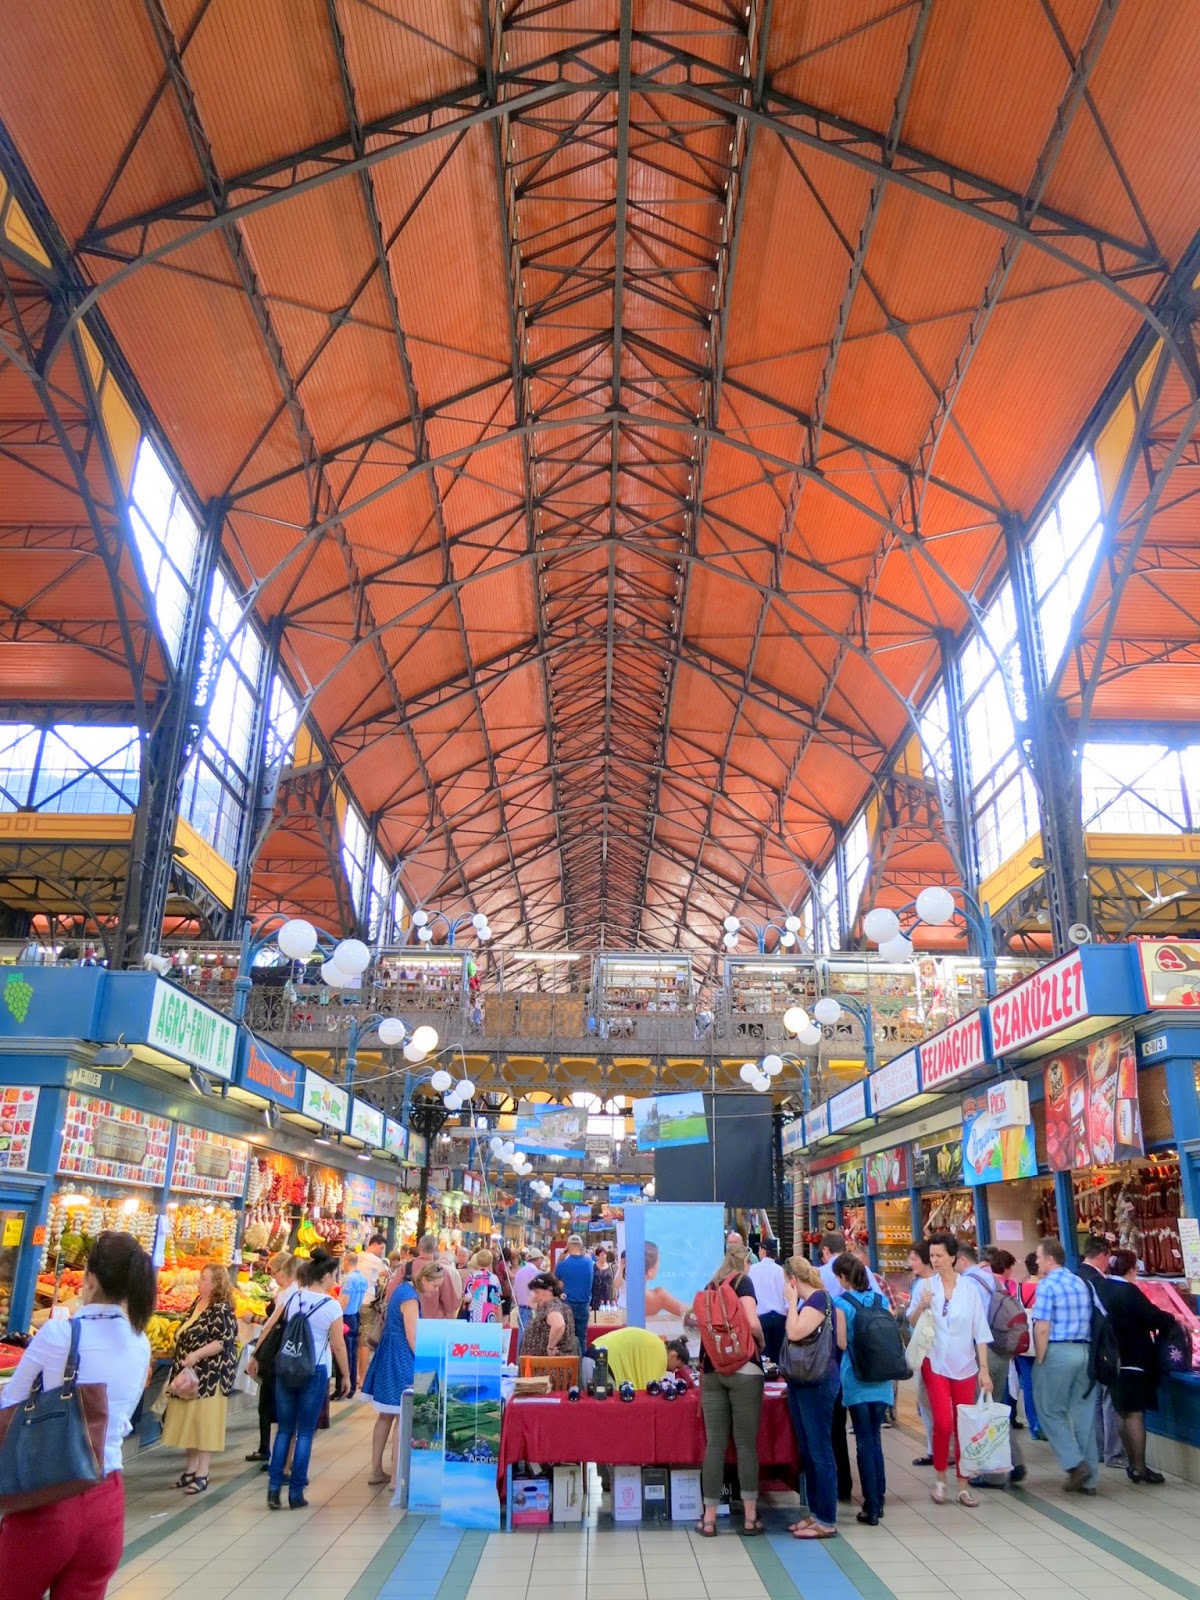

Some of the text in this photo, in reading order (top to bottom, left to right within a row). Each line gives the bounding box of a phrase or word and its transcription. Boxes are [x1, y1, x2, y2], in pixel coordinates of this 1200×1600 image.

[156, 990, 217, 1062] AGRO-FRUIT
[993, 961, 1082, 1050] SZAKÜZLET
[921, 1020, 982, 1084] FELVÁGOTT
[990, 1092, 1006, 1115] PICK
[470, 1350, 500, 1358] PORTUGAL
